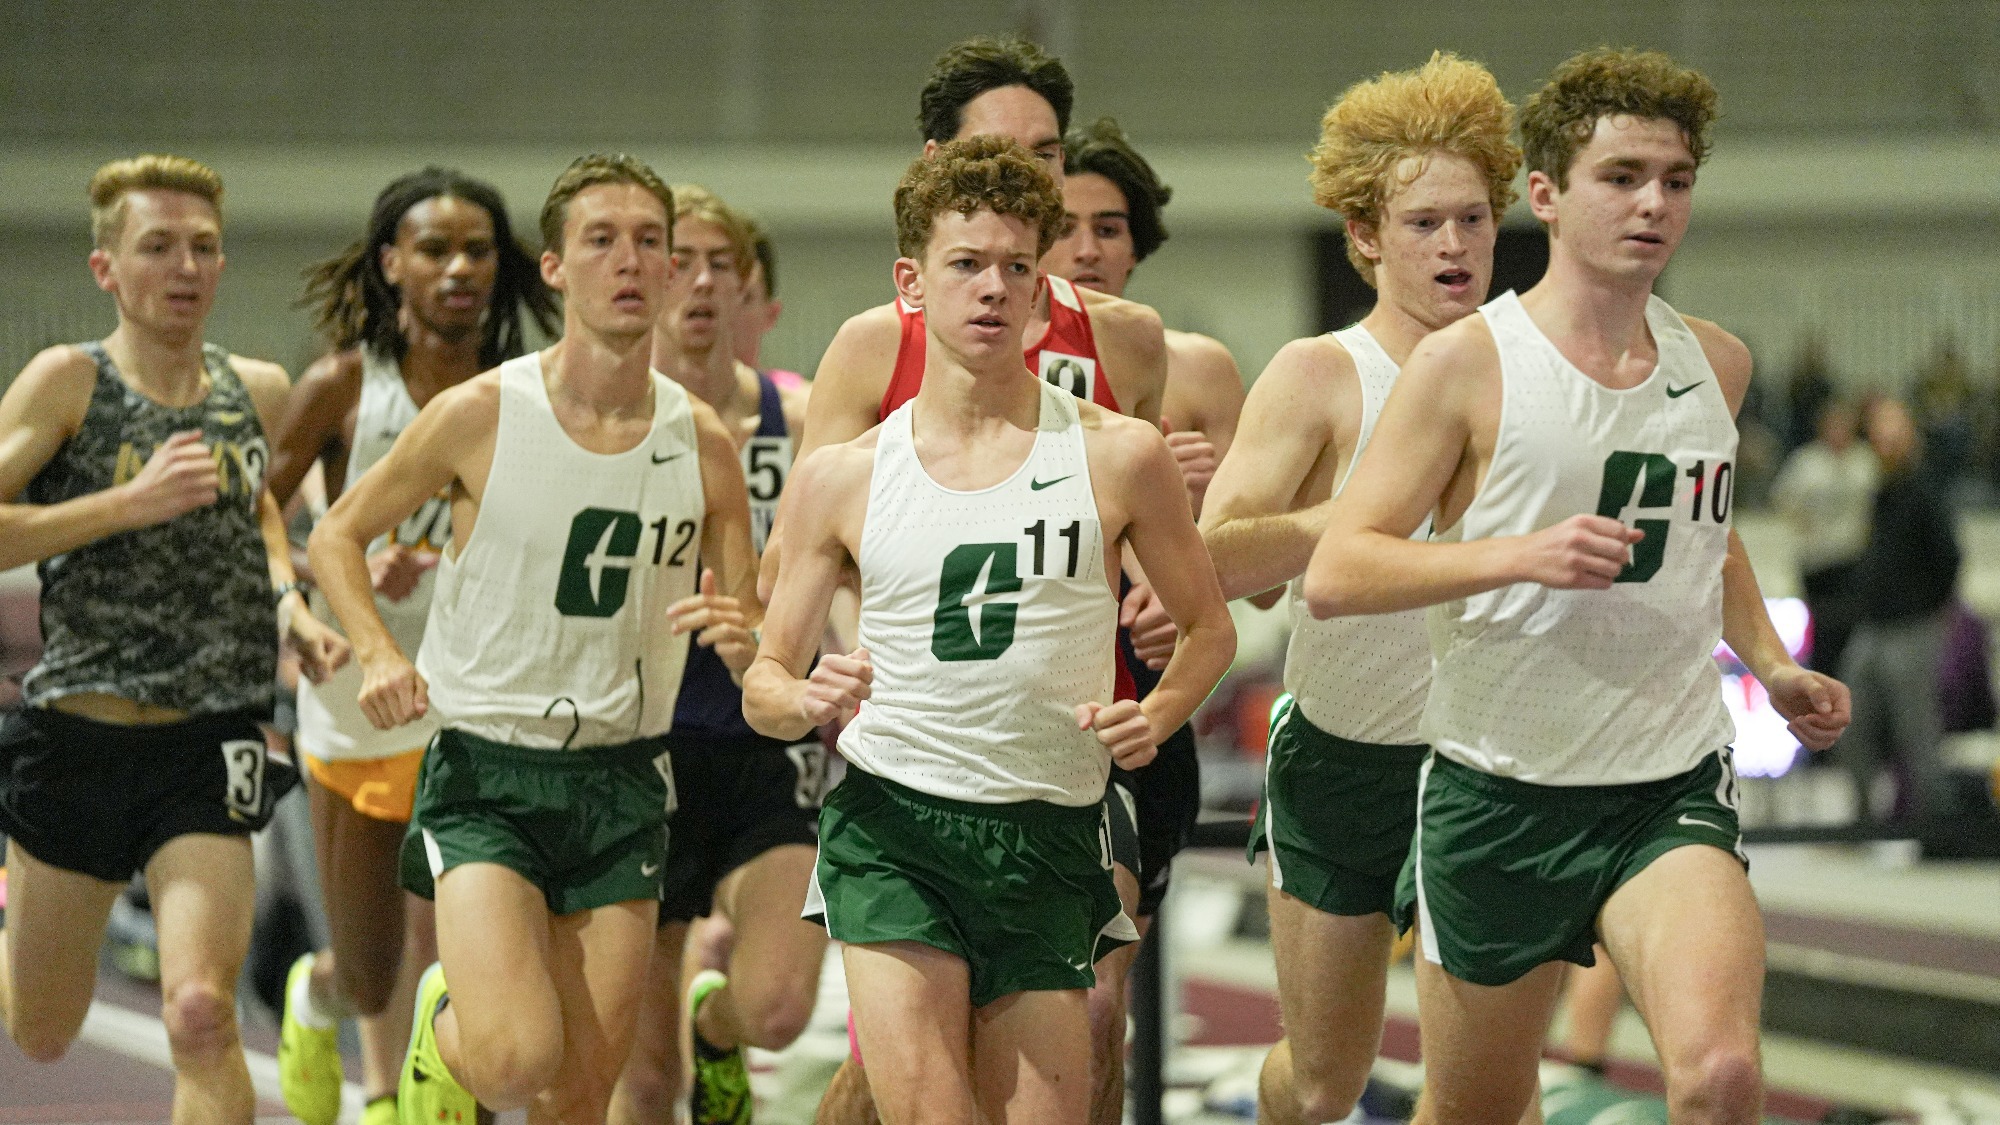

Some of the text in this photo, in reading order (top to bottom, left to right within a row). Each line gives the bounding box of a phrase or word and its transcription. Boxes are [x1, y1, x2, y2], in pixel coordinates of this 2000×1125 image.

[750, 445, 783, 501] 5
[1686, 459, 1732, 524] 10
[650, 514, 696, 567] 12
[1023, 519, 1080, 578] 11
[233, 748, 258, 806] 3
